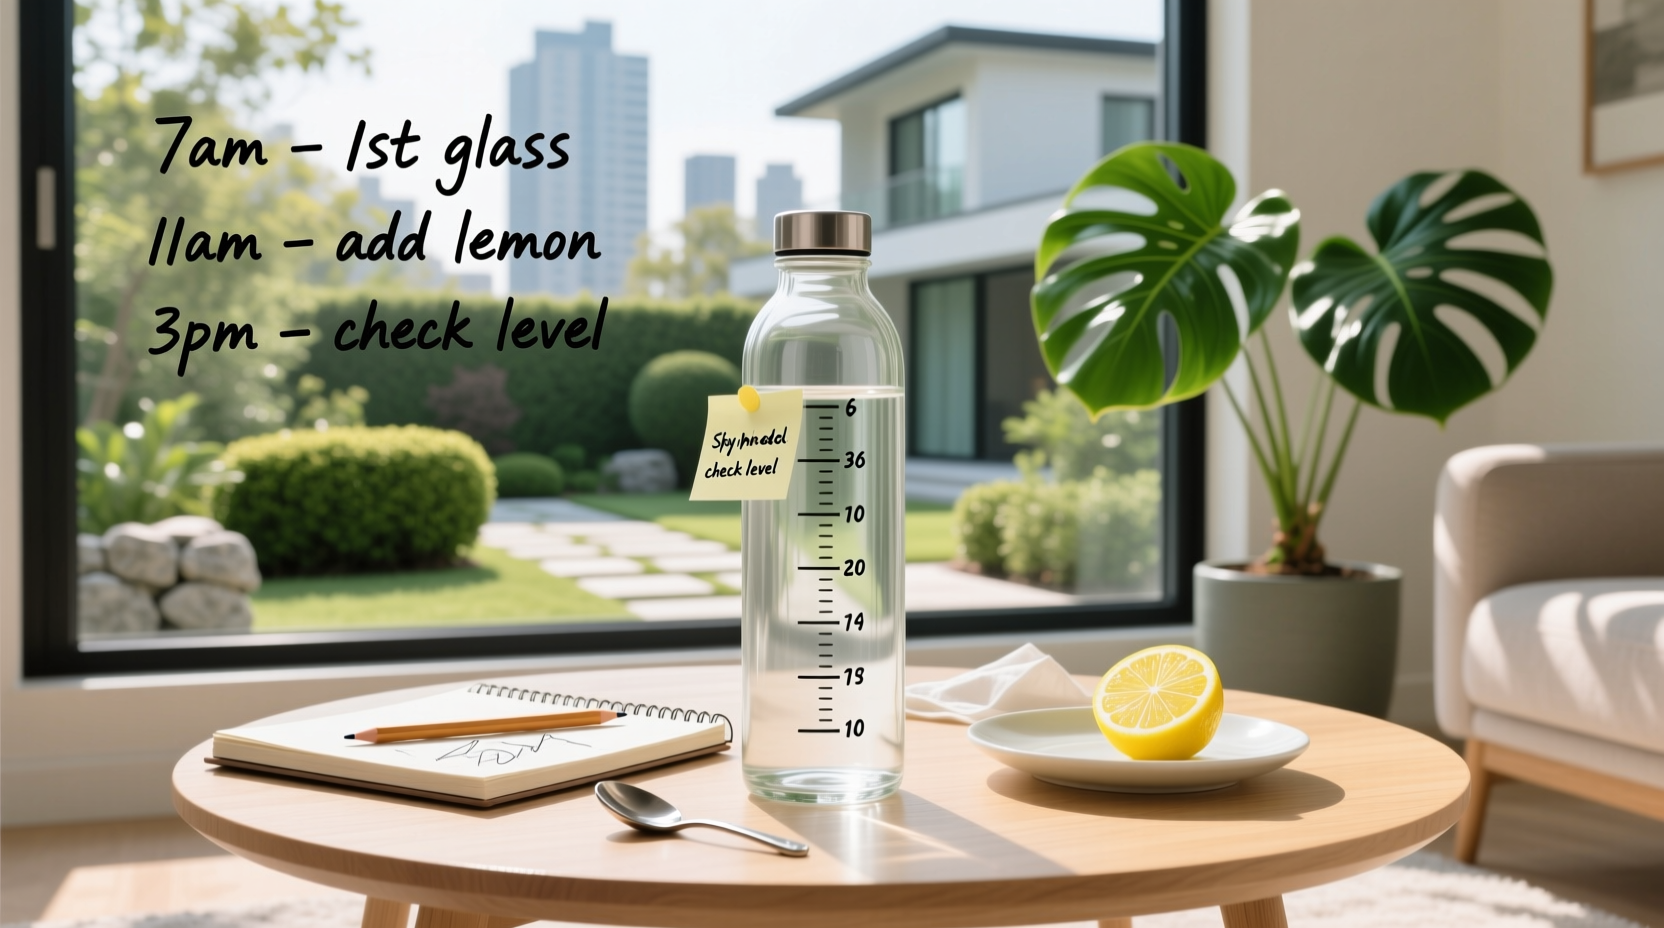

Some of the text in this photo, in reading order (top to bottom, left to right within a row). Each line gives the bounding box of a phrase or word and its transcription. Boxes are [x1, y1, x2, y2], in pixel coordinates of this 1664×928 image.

[154, 115, 268, 175] 7am
[346, 119, 421, 172] 1st
[435, 113, 570, 196] glass
[148, 216, 262, 266] 11am
[336, 209, 432, 262] add
[454, 209, 602, 264] lemon
[148, 306, 258, 378] 3pm
[334, 298, 474, 351] check
[496, 296, 609, 352] level
[845, 398, 857, 417] 6
[704, 457, 779, 479] check level
[843, 451, 866, 469] 36
[844, 504, 865, 523] 10
[843, 559, 866, 577] 20
[845, 719, 865, 738] 10
